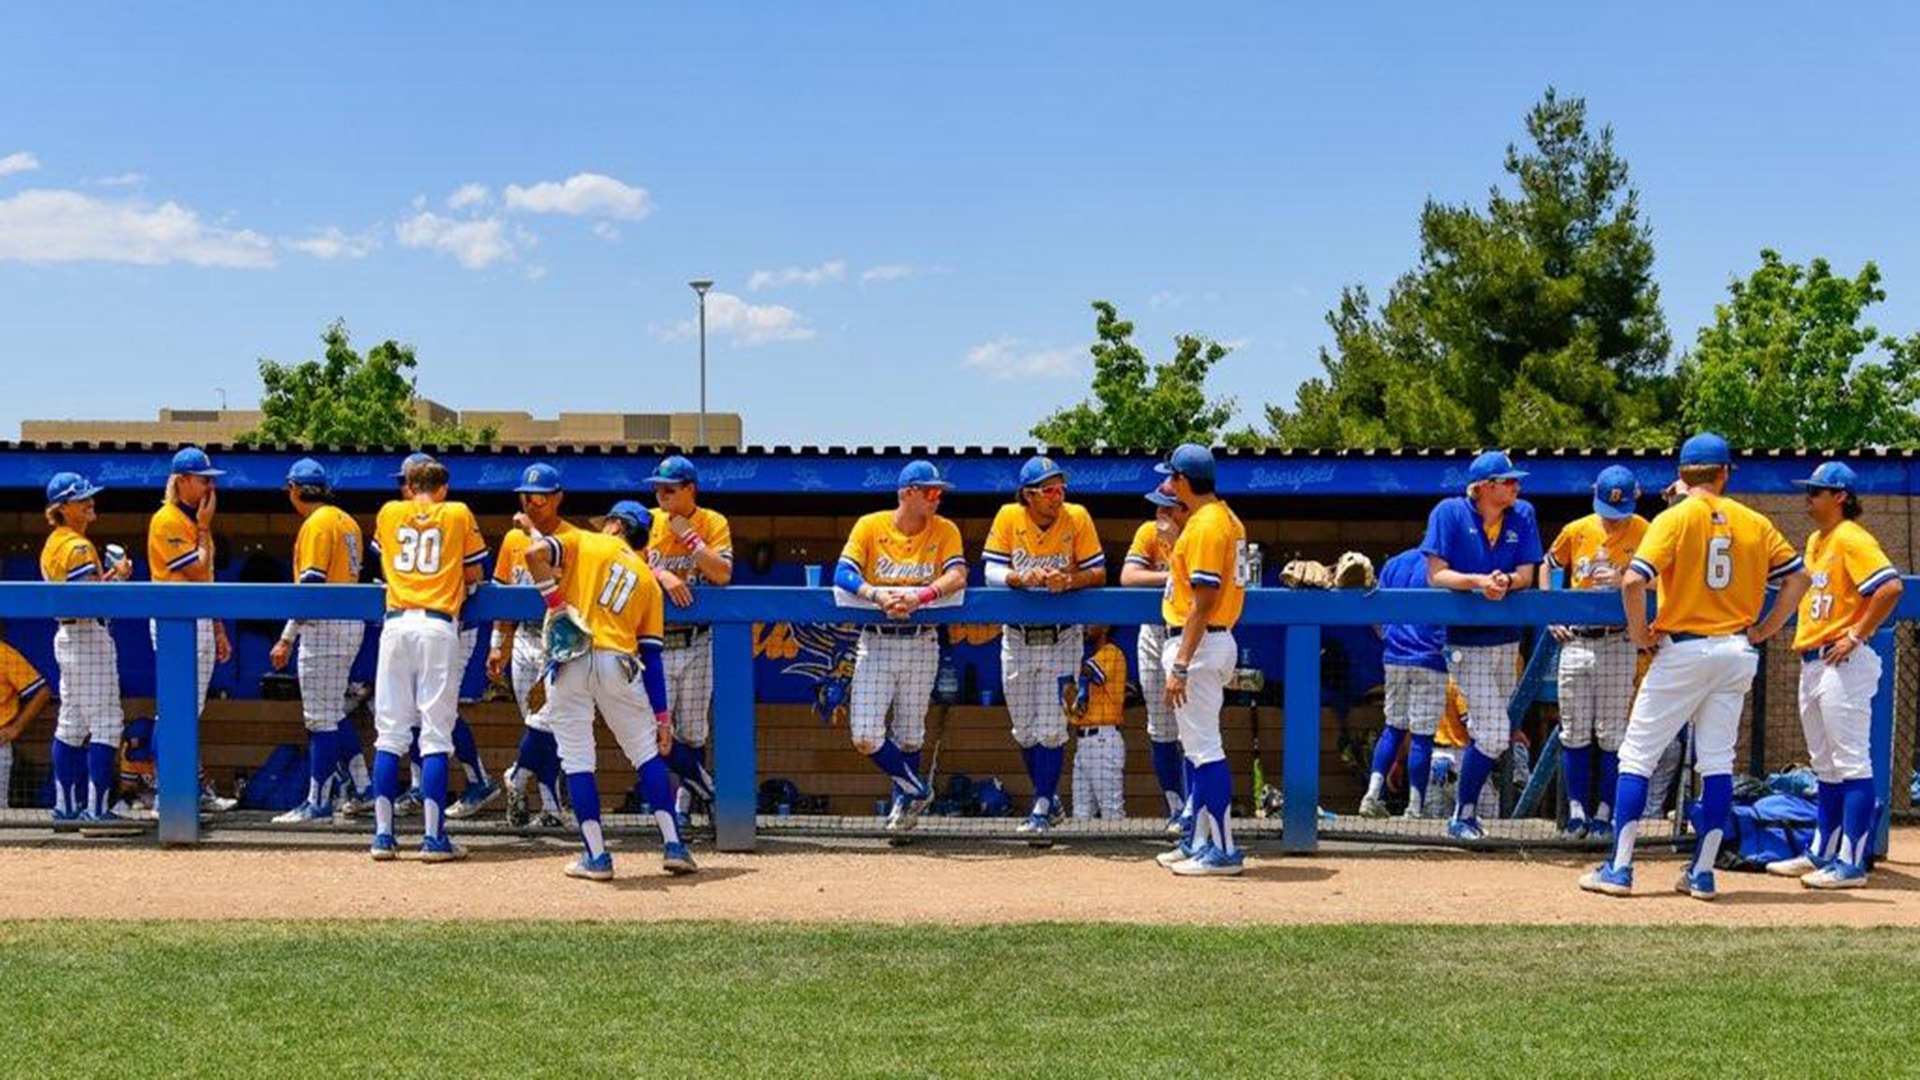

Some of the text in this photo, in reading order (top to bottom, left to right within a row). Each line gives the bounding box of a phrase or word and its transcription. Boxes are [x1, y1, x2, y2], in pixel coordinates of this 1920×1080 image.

[393, 526, 442, 575] 30
[1705, 536, 1733, 590] 6
[597, 561, 640, 615] 11
[1809, 593, 1834, 620] 37
